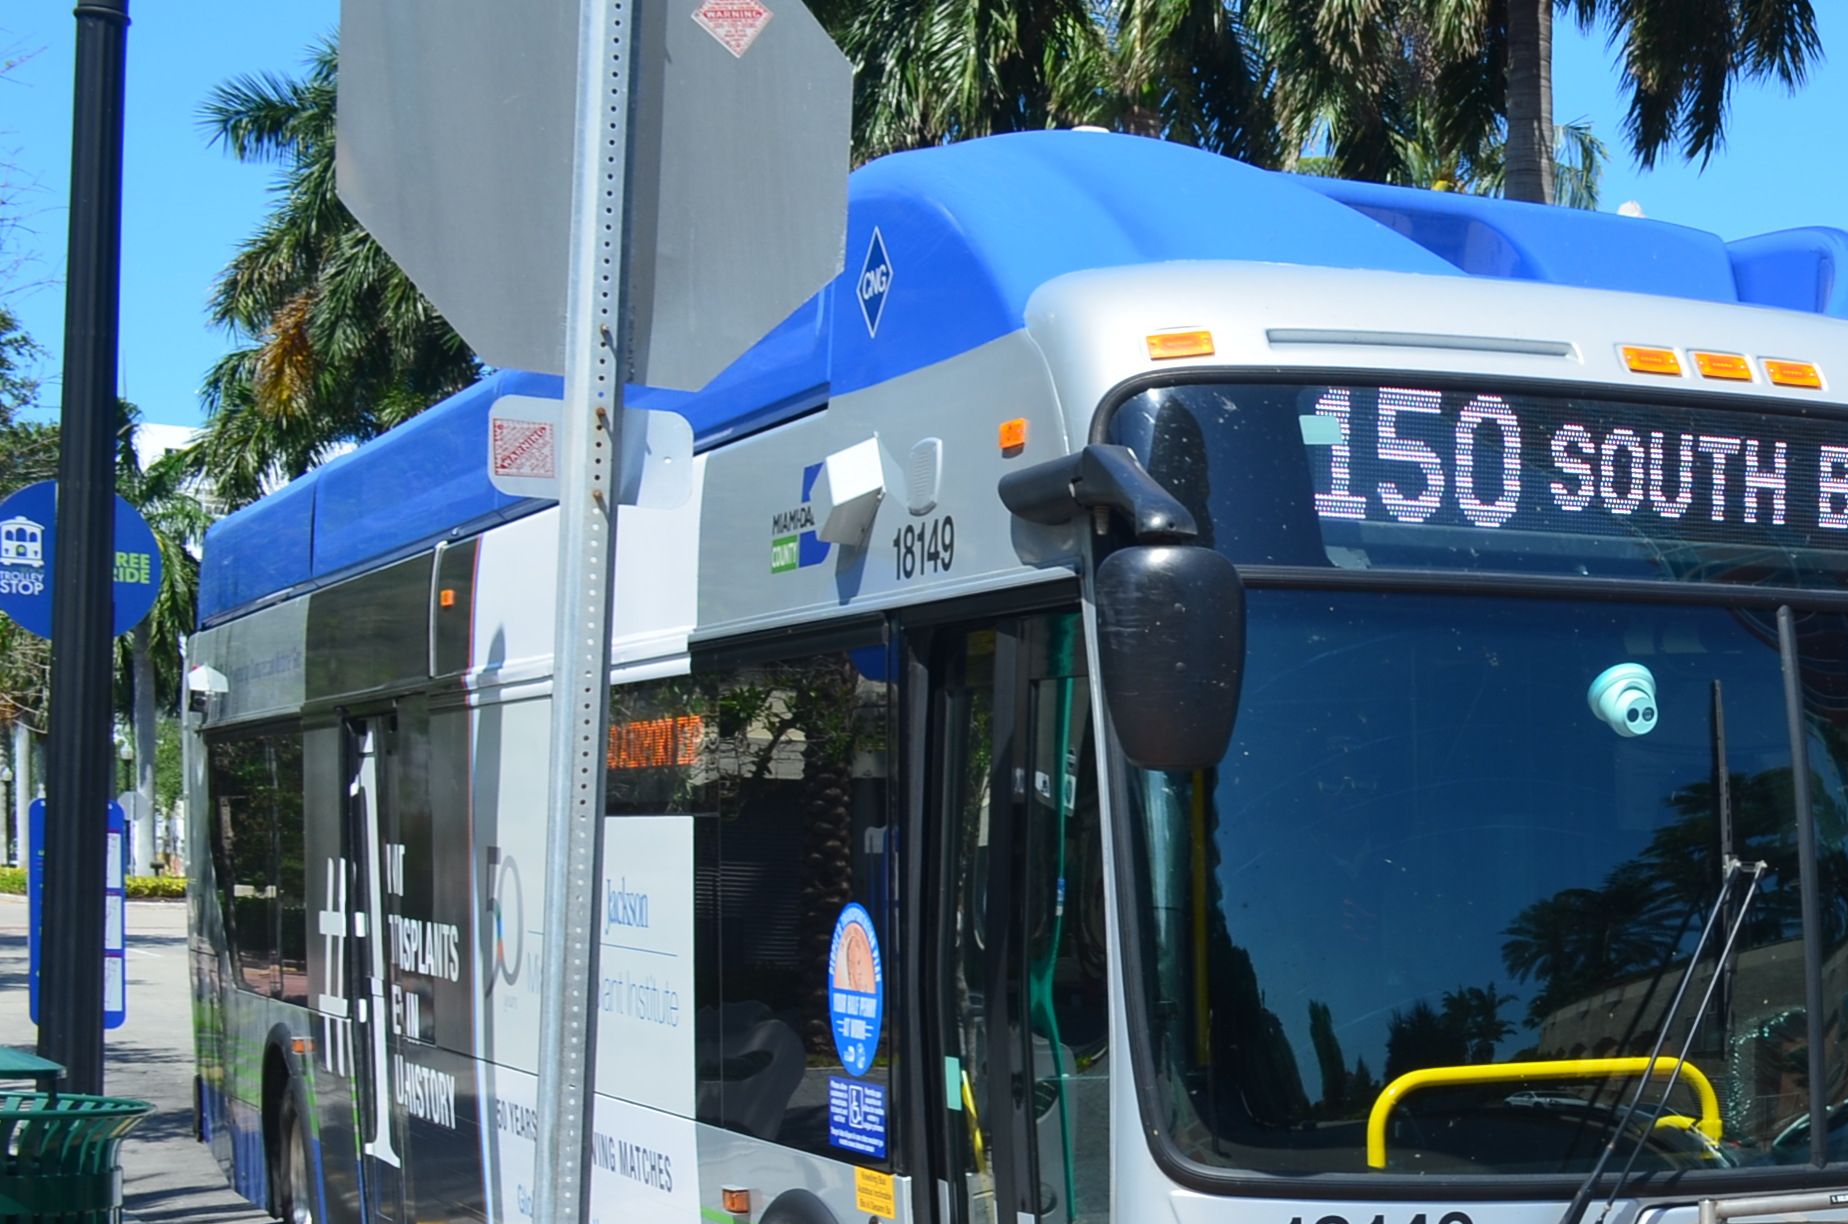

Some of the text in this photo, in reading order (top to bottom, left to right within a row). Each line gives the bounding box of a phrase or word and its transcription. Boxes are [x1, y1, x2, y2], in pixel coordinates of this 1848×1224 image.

[862, 264, 887, 300] CNG
[1314, 387, 1522, 527] 150
[1550, 424, 1786, 527] SOUTH
[772, 505, 816, 535] MIAMI-DA
[114, 552, 150, 569] REE
[893, 515, 955, 580] 18149
[0, 571, 44, 583] TROLLEY
[0, 581, 45, 596] STOP
[605, 876, 649, 935] Jackson
[627, 970, 680, 1028] Institute
[618, 1139, 673, 1193] MATCHES
